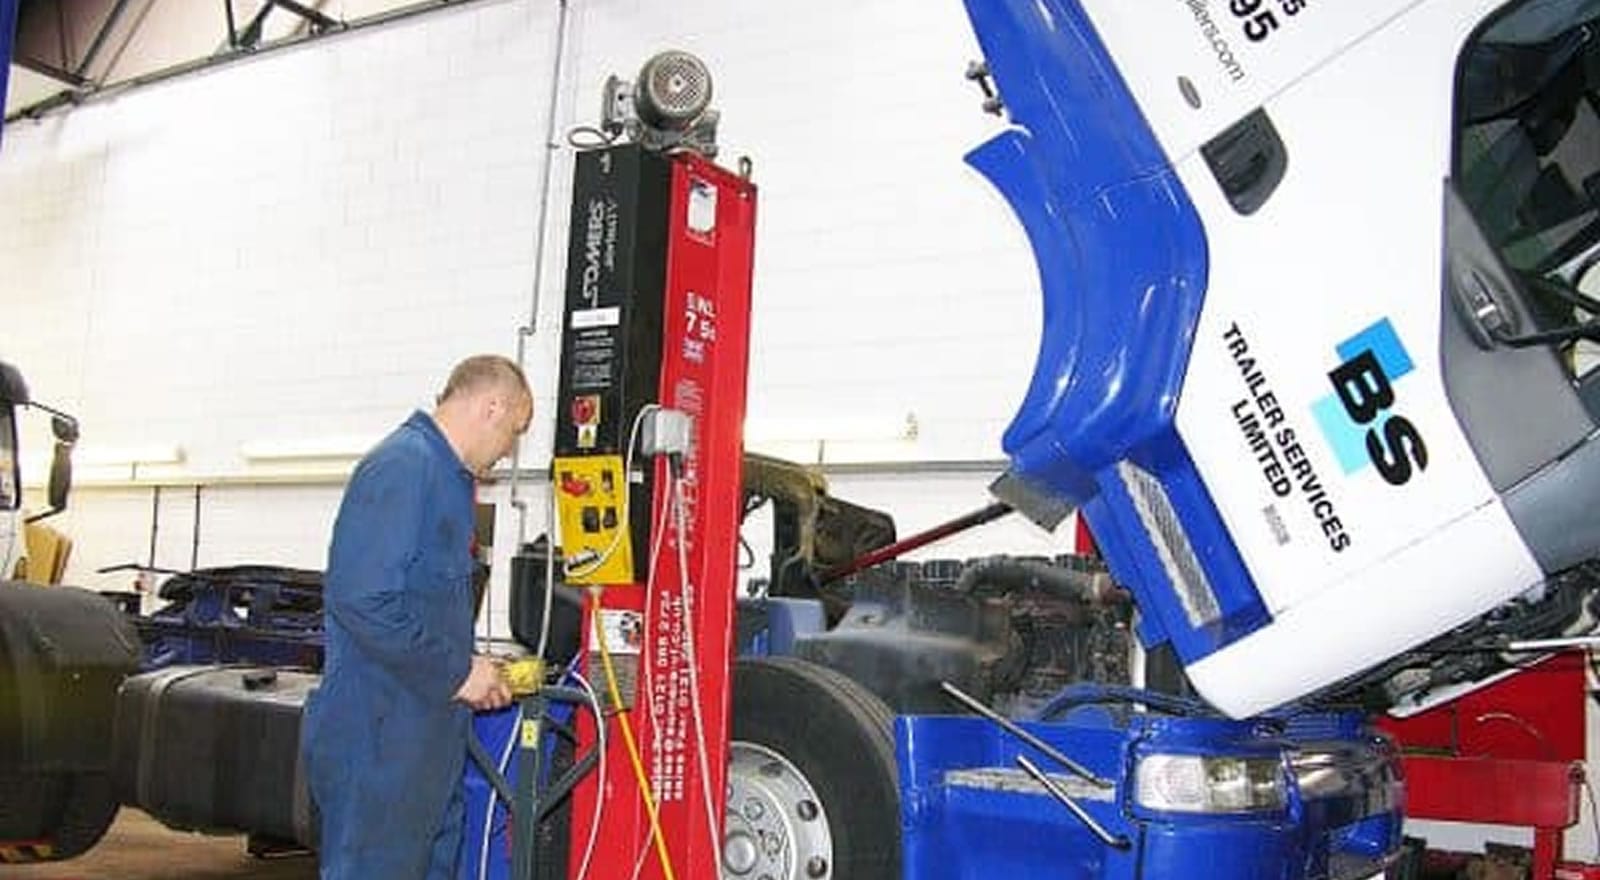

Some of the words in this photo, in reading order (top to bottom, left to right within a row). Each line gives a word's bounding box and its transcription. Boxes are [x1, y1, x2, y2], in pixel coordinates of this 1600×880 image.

[1223, 321, 1285, 428] TRAILER
[1276, 427, 1351, 553] SERVICES
[1231, 399, 1292, 498] LIMITED
[1327, 348, 1428, 486] BS
